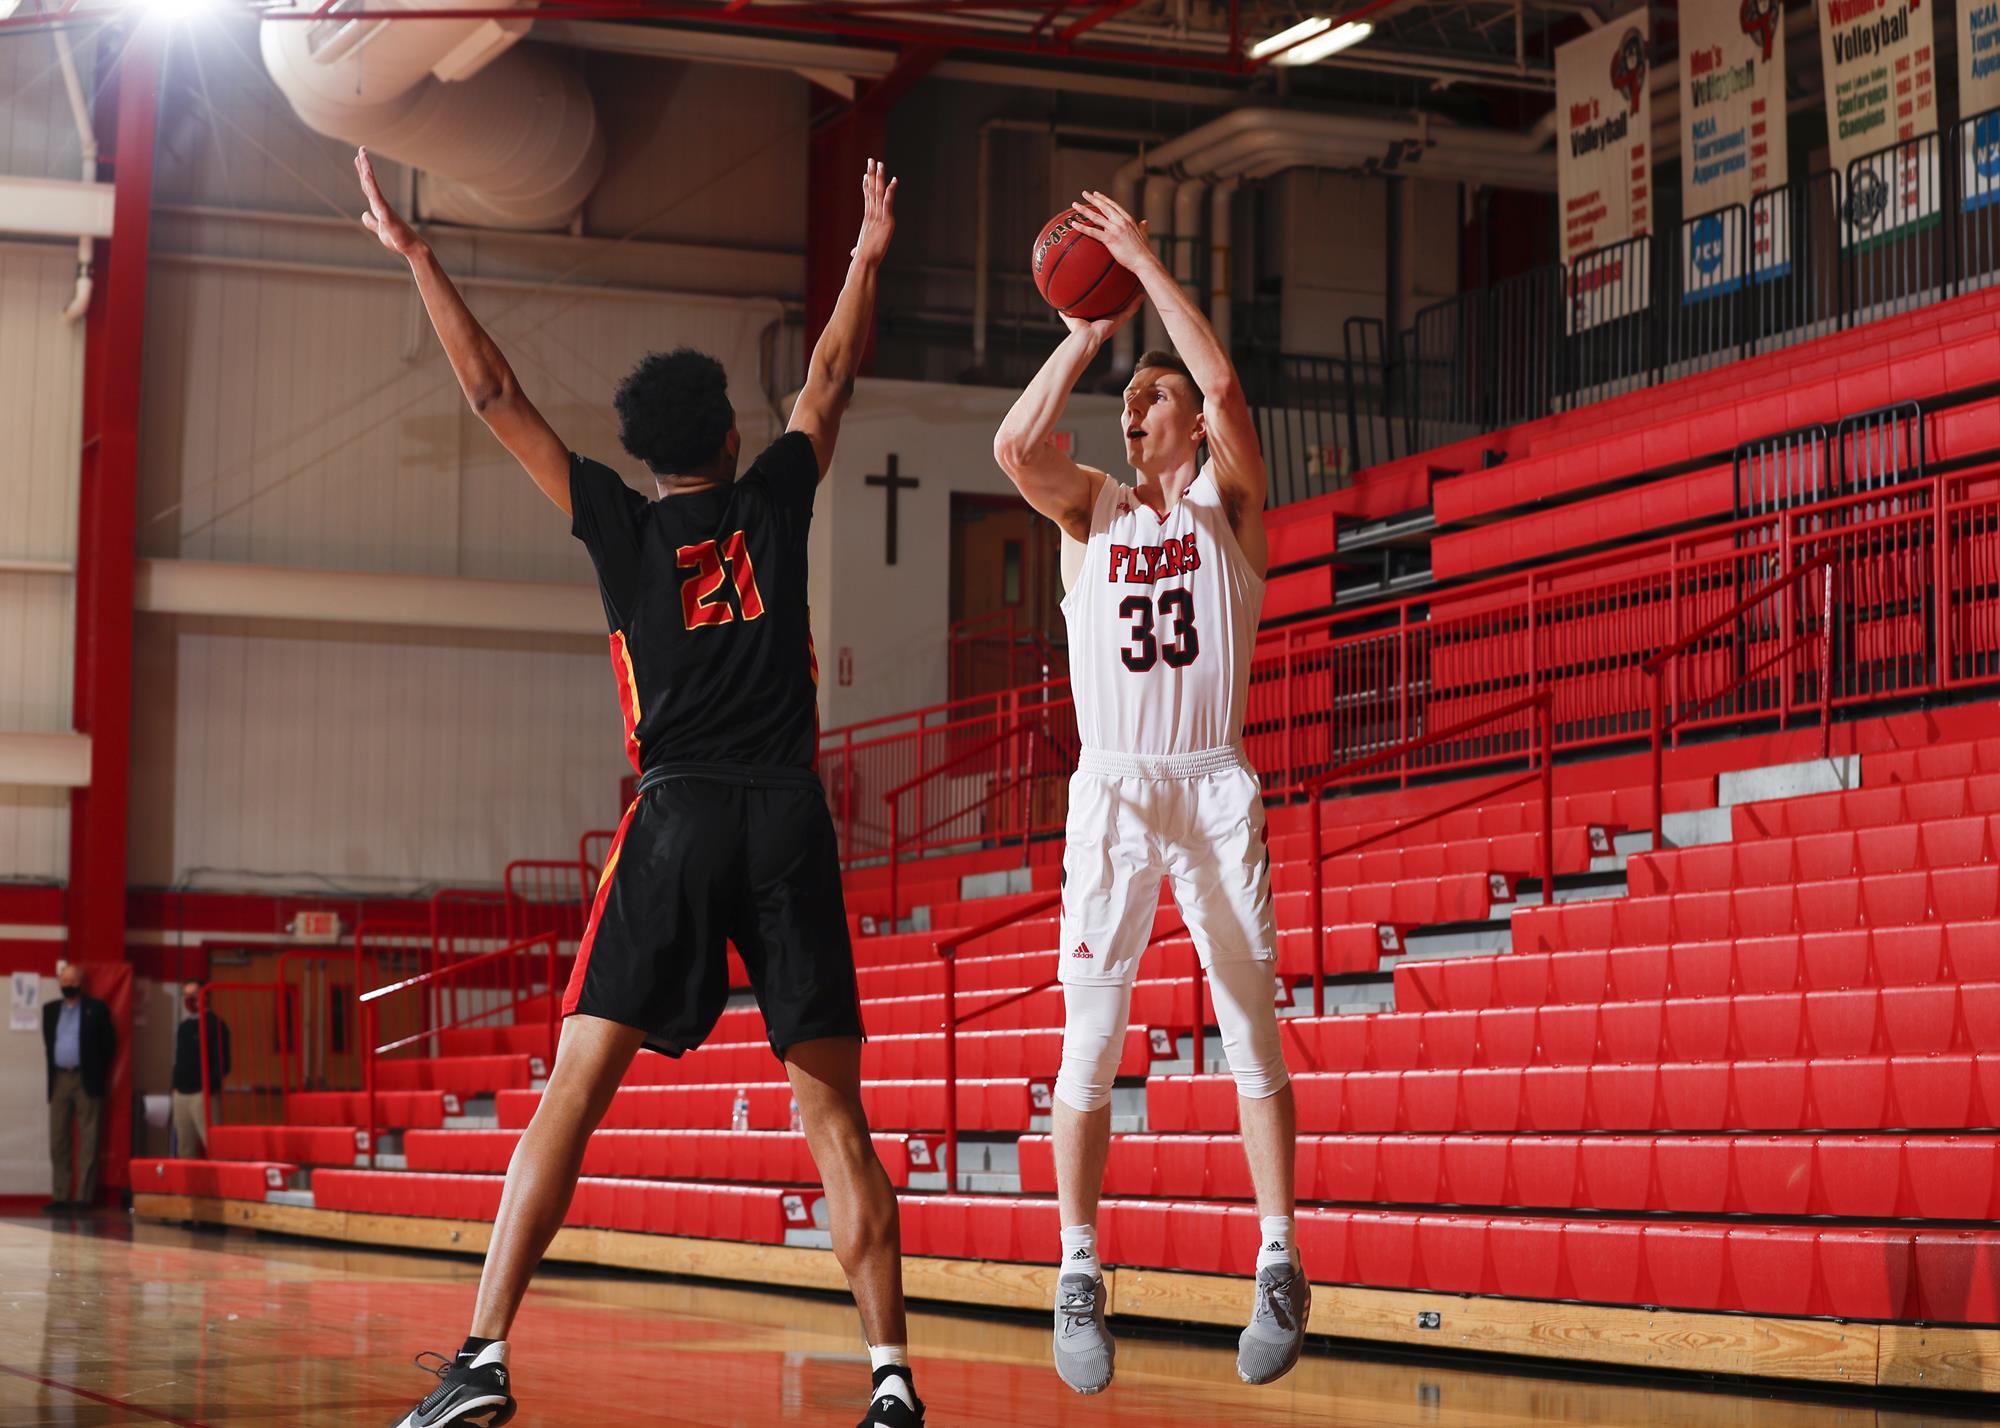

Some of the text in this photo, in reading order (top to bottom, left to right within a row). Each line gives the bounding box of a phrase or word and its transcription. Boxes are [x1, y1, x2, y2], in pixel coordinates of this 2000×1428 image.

[1833, 5, 1908, 64] Volleyball
[1691, 58, 1754, 107] Volleyball
[1570, 109, 1627, 159] Volleyball
[676, 529, 765, 631] 21
[1119, 587, 1200, 673] 33
[1071, 951, 1095, 959] adidas
